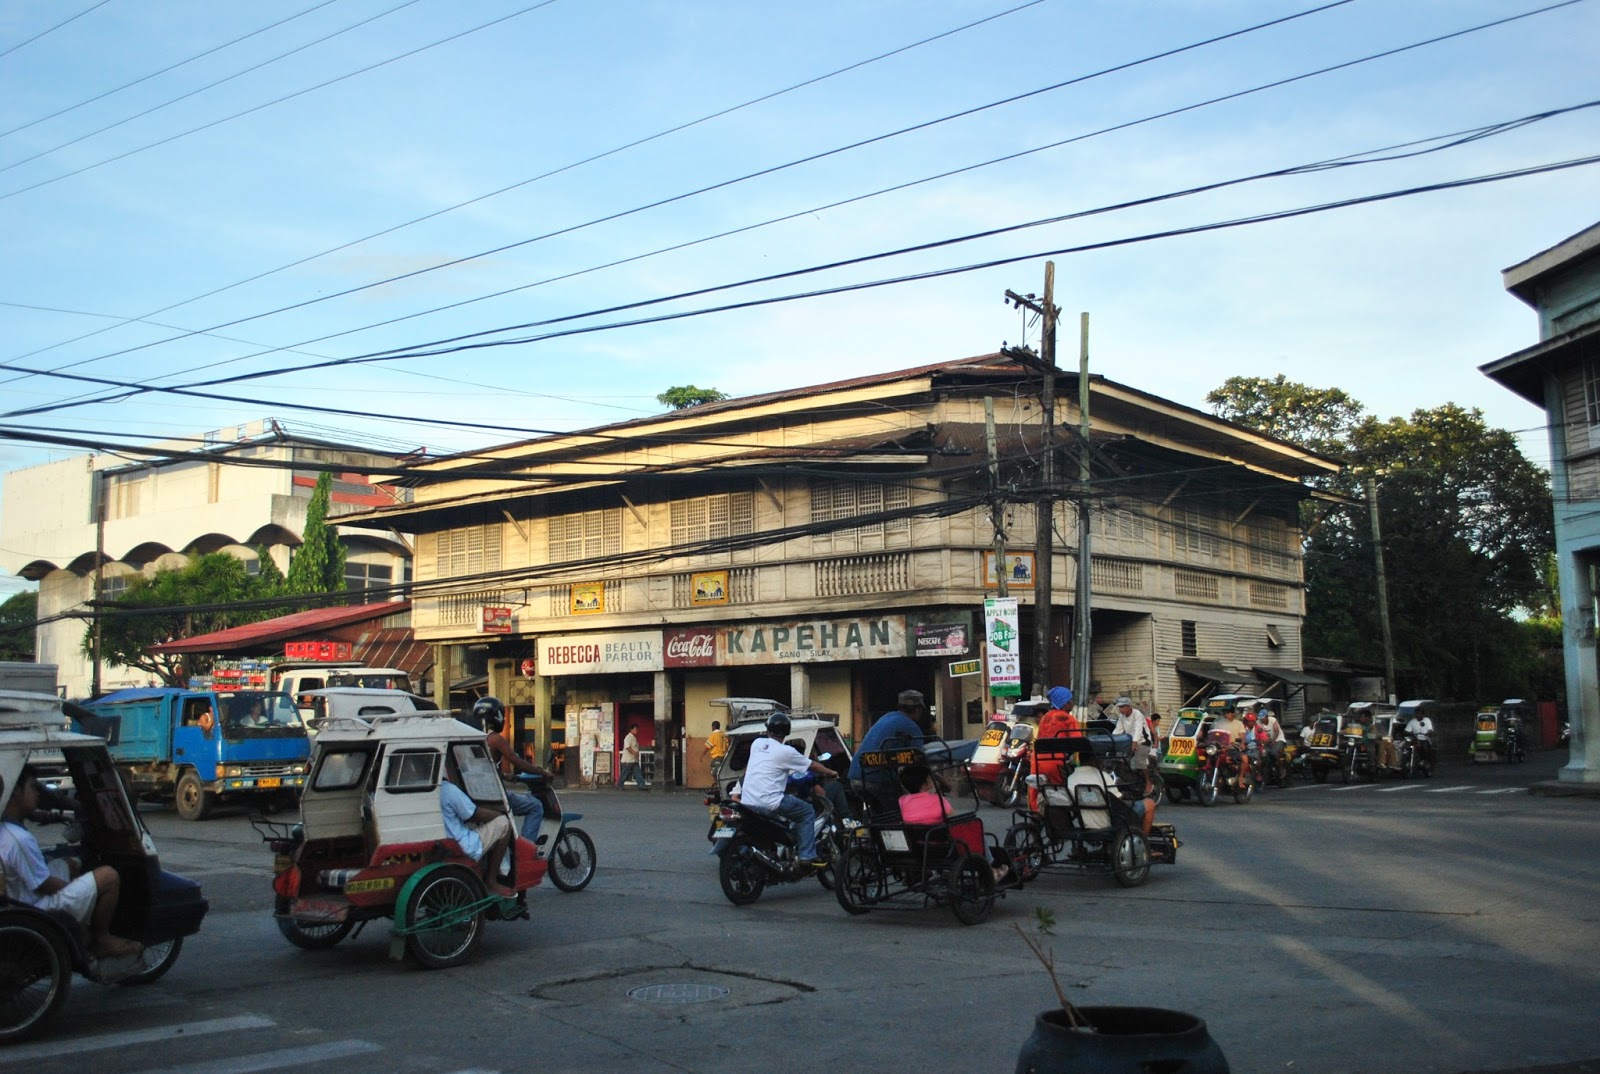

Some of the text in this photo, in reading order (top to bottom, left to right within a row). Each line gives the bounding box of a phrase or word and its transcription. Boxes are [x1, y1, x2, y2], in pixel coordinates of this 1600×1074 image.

[727, 620, 890, 654] KAPEHAN
[990, 632, 1003, 641] JOB
[606, 640, 652, 652] BEAUTY
[667, 634, 714, 658] Coca-Cola
[548, 644, 600, 664] REBECCA
[606, 652, 652, 662] PARLOR
[779, 650, 800, 658] SANG
